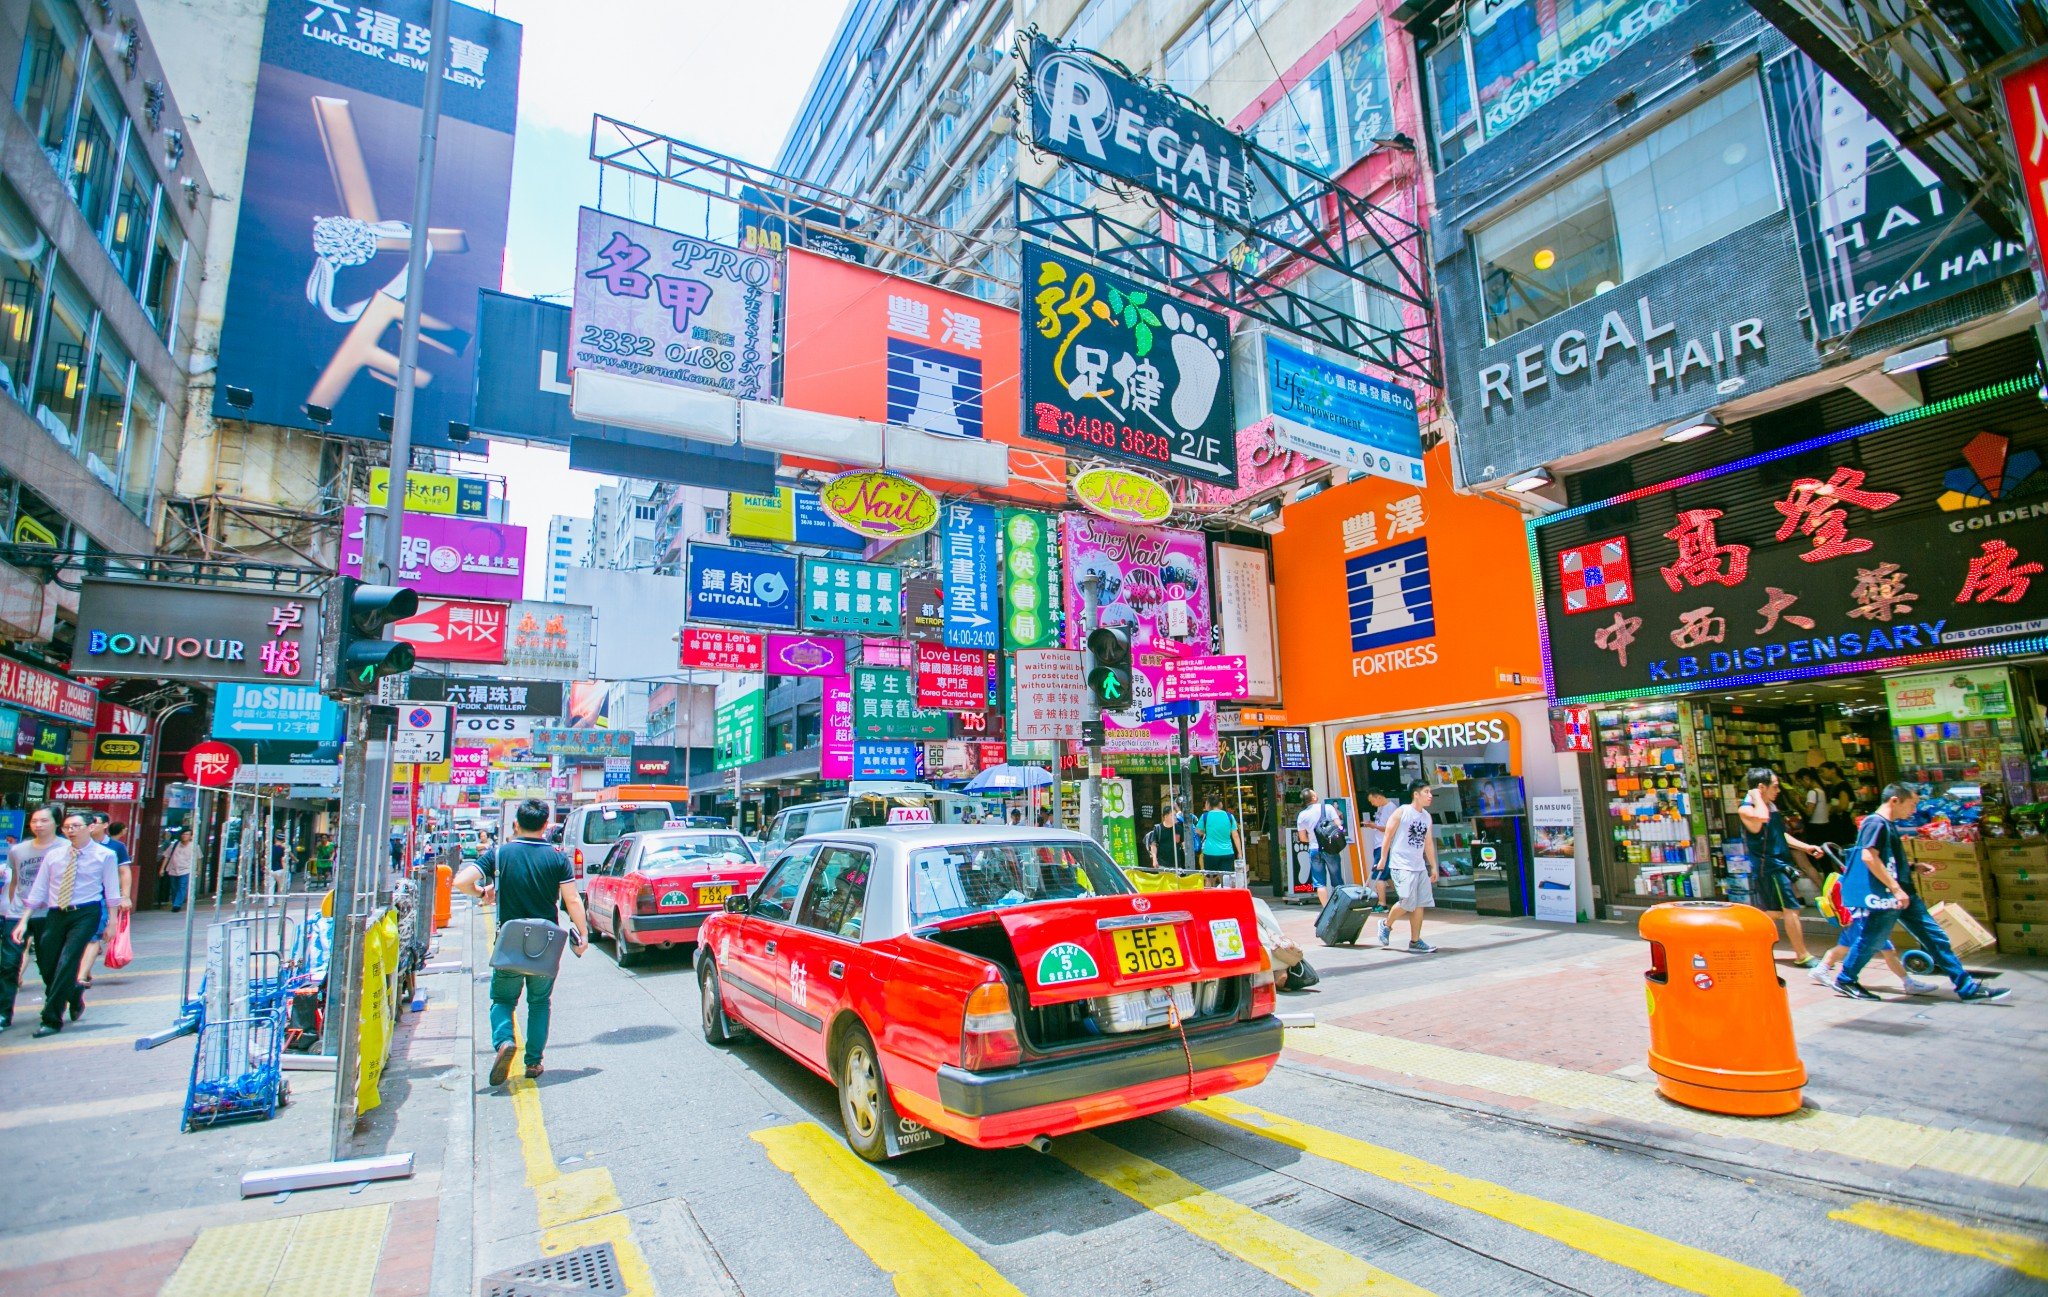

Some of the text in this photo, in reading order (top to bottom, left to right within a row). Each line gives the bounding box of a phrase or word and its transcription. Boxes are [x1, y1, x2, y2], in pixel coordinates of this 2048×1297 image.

[302, 24, 487, 90] LUKFOOK JEWLERY
[1049, 60, 1240, 198] REGAL
[1156, 167, 1240, 222] HAIR
[746, 225, 782, 252] BAR
[672, 240, 770, 288] PRO
[585, 231, 713, 333] 名甲
[1829, 271, 1930, 323] REGAL
[887, 295, 982, 350] 豐澤
[581, 325, 736, 373] 2332 0188
[1479, 296, 1765, 409] REGAL HAIR
[577, 351, 736, 391] www.supernail.com.hk
[1275, 358, 1306, 412] Life
[1296, 396, 1362, 431] Empowerment
[1063, 412, 1169, 461] 3488 3628
[1180, 431, 1220, 461] 2/F
[744, 496, 782, 508] MATCHES
[831, 481, 923, 524] Nail
[1082, 476, 1157, 513] Nail
[1342, 494, 1425, 554] 豐澤
[1948, 502, 2048, 533] GOLDEN
[1660, 466, 1901, 593] 高登
[1077, 519, 1170, 567] Super Nail
[949, 504, 976, 612] 序言書室
[698, 592, 761, 608] CITICALL
[449, 606, 499, 626] 美心
[447, 624, 497, 643] MX
[696, 631, 750, 643] Love Lens
[949, 629, 995, 647] 14:00-24:00
[1969, 624, 2022, 638] GORDON
[88, 628, 245, 662] BONJOUR
[920, 649, 951, 661] Love
[953, 651, 981, 663] Lens
[1025, 663, 1057, 671] waiting
[1352, 643, 1438, 678] FORTRESS
[936, 677, 968, 690] 專門店
[1032, 672, 1079, 680] prosecuted
[67, 686, 91, 702] MONEY
[233, 685, 322, 711] JoShin
[446, 684, 528, 704] 六福珠寶
[941, 690, 968, 698] Contact
[1032, 693, 1080, 704] 停車等候
[1135, 686, 1153, 697] $68
[59, 699, 95, 722] EXCHANGE
[484, 703, 527, 711] JEWELLERY
[1033, 708, 1080, 719] 會被檢控
[456, 718, 515, 731] rocs
[1404, 719, 1505, 752] FORTRESS
[426, 734, 435, 743] 7
[426, 751, 441, 762] 12
[55, 780, 133, 794] 人民幣找換
[897, 809, 929, 821] TAXI
[708, 886, 722, 895] KK
[1051, 943, 1079, 957] TAXI
[1131, 927, 1157, 950] EF
[790, 960, 807, 983] 的士
[1060, 955, 1073, 971] 5
[1125, 948, 1176, 974] 3103
[1049, 968, 1088, 981] SEATS
[790, 983, 807, 1008] TAXI
[897, 1130, 931, 1147] TOYOTA
